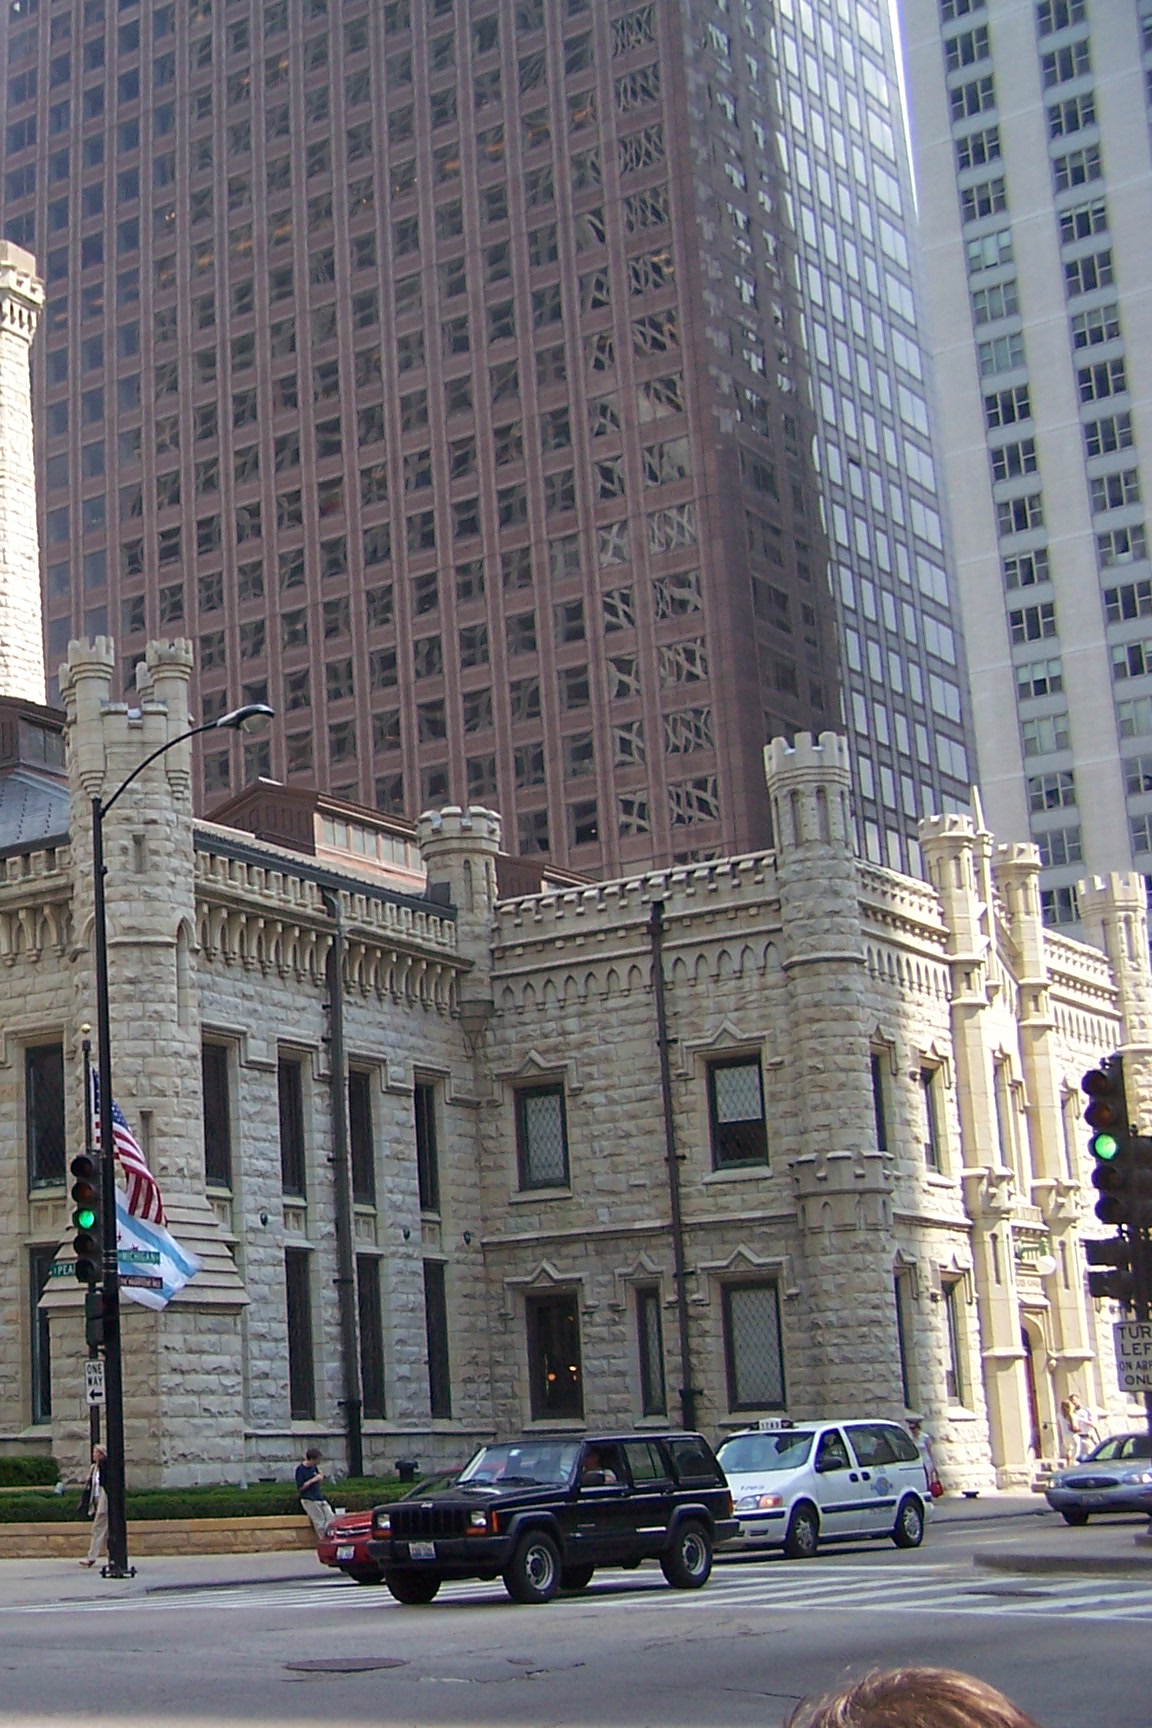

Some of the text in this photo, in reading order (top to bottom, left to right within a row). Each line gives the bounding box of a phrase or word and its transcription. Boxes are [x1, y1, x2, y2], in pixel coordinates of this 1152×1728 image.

[121, 1251, 155, 1262] MICHIGAN
[57, 1264, 76, 1276] PEA
[87, 1363, 103, 1374] ONE
[1119, 1360, 1133, 1370] ON
[87, 1376, 103, 1386] WAY
